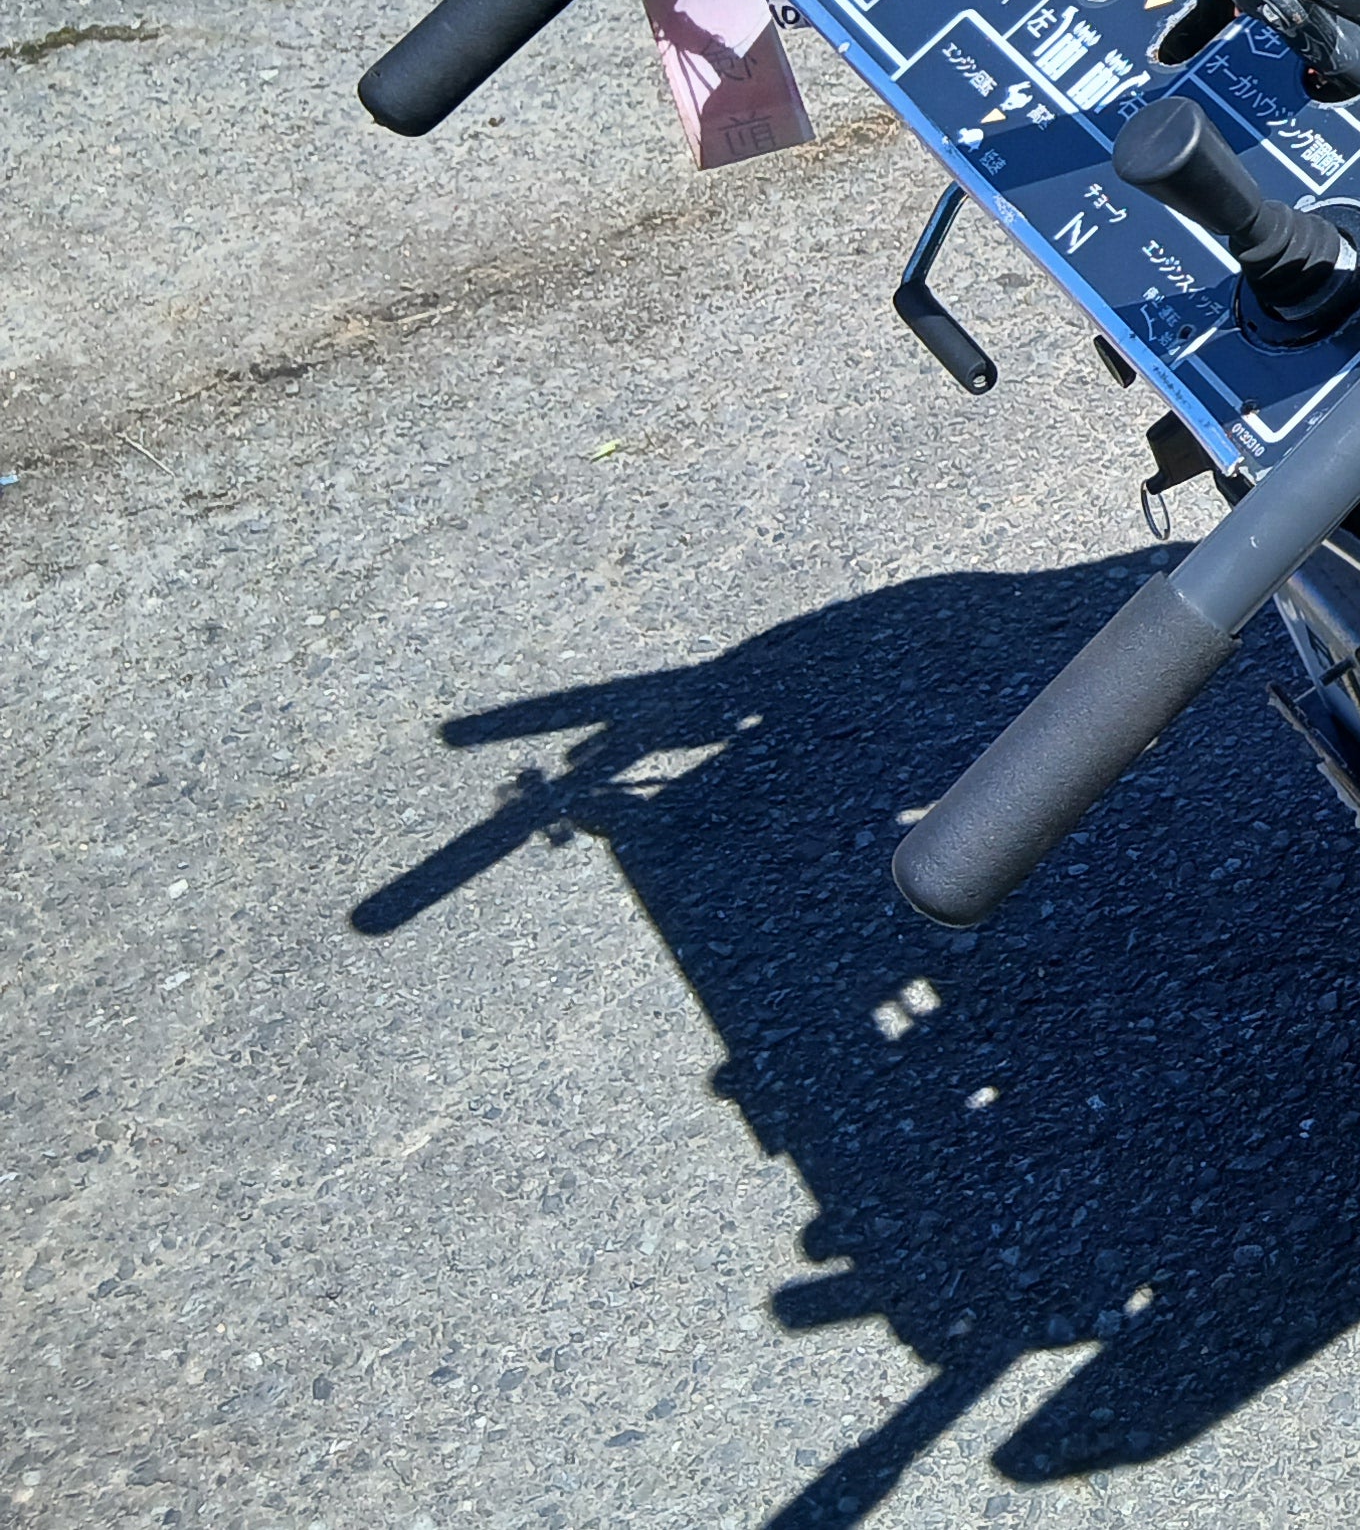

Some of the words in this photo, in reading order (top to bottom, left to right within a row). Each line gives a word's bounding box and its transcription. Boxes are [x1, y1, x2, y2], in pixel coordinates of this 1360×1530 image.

[1027, 8, 1057, 38] 左
[942, 42, 997, 97] エンジン回転
[1118, 90, 1149, 120] 右
[1205, 54, 1345, 176] オーガハウジング調節
[979, 149, 1006, 176] 低速
[1084, 183, 1127, 223] チョーク
[1141, 239, 1225, 316] エンジンスイッチ
[1143, 287, 1165, 308] 停止
